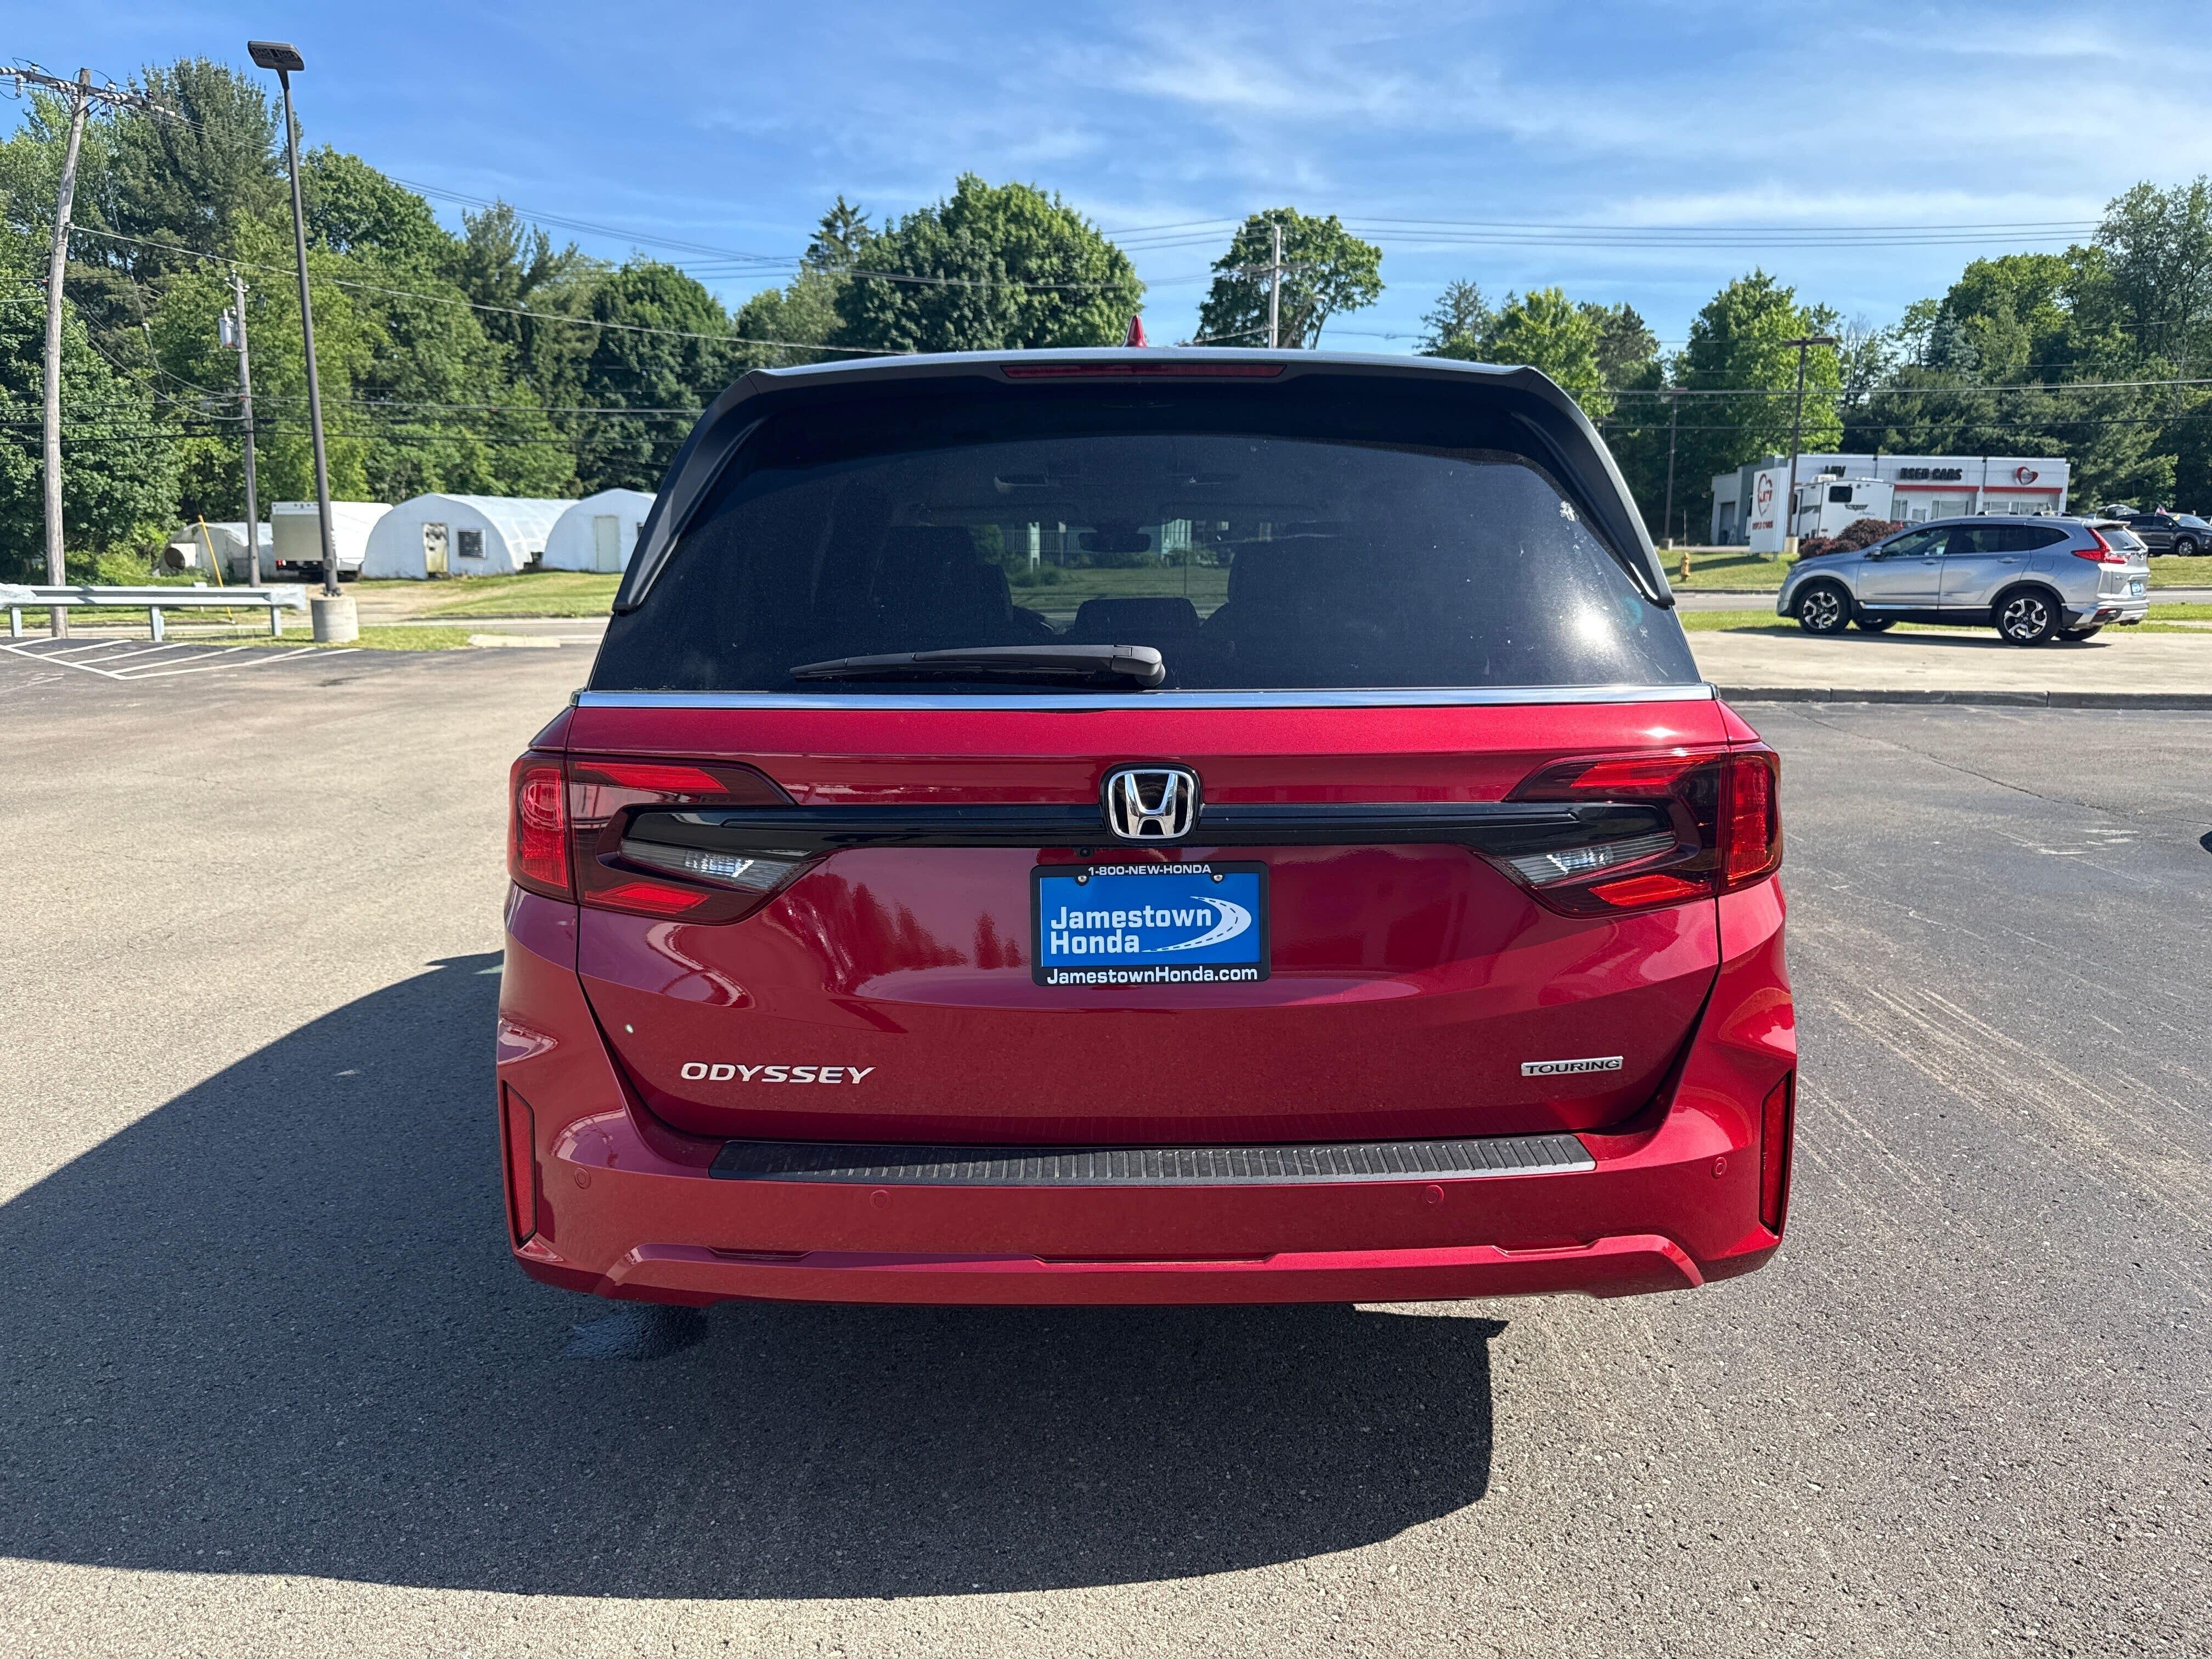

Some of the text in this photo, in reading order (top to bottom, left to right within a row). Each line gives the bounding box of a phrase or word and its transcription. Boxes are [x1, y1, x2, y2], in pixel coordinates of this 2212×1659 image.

[1932, 468, 1962, 480] CARS
[1088, 864, 1212, 876] 1-800-NEW-HONDA
[1051, 905, 1212, 929] Jamestown
[1050, 929, 1139, 955] Honda
[1047, 966, 1258, 984] JamestownHonda.com
[680, 1062, 877, 1084] ODYSSEY
[1525, 1059, 1620, 1074] TOURING
